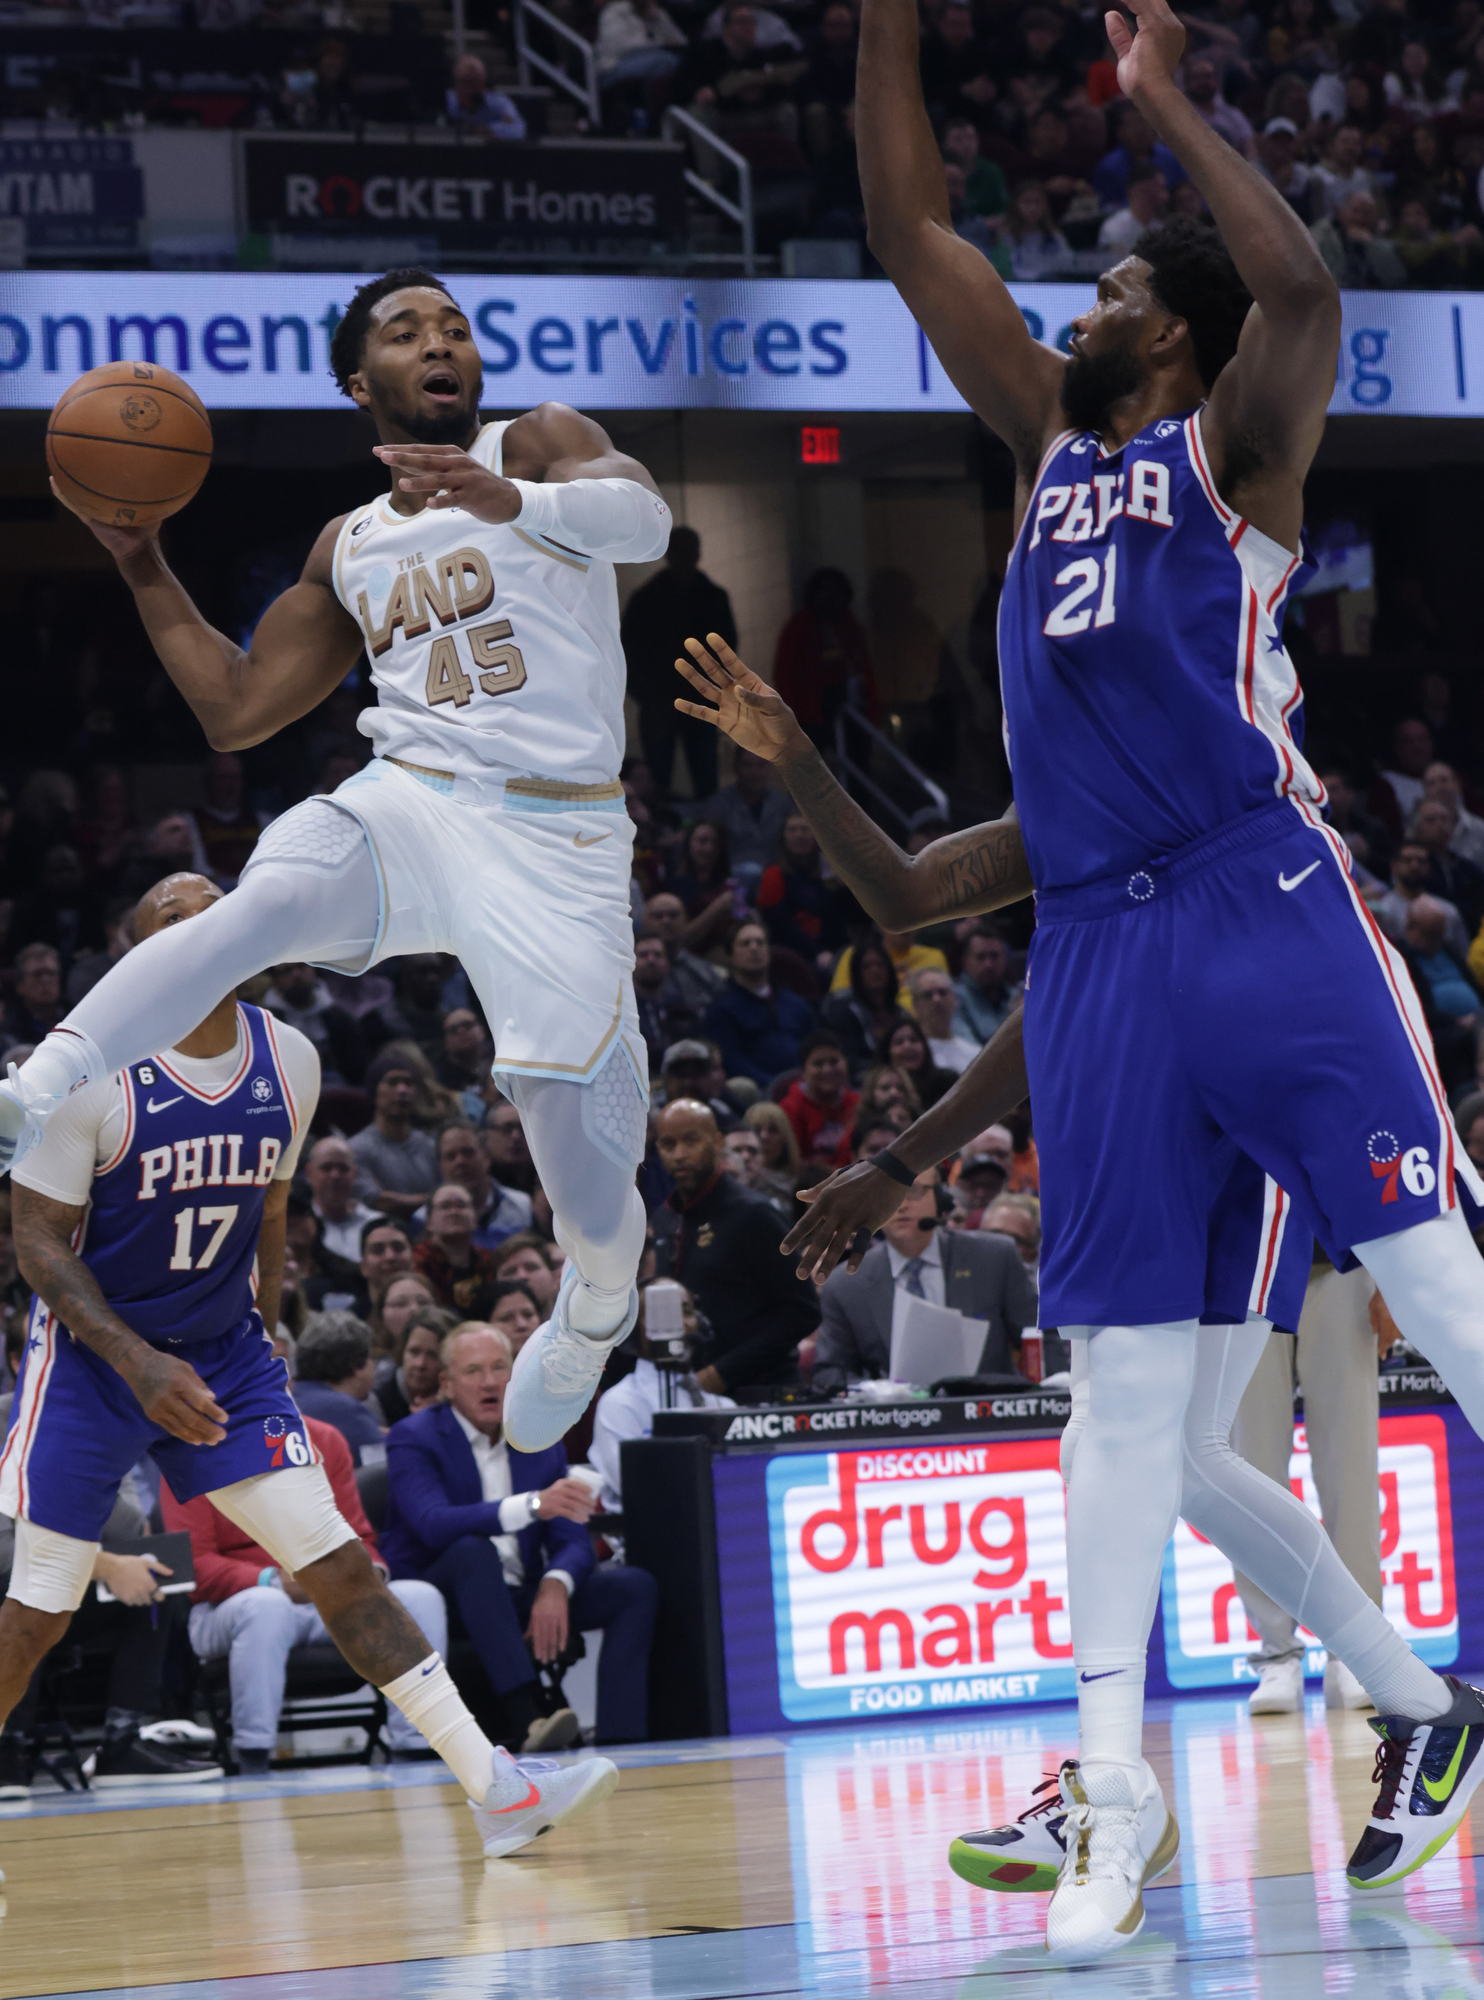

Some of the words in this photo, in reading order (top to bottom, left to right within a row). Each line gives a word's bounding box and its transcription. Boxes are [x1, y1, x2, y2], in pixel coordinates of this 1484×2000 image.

[284, 173, 494, 220] ROCKET
[502, 180, 657, 226] Homes
[475, 296, 848, 376] Services
[397, 551, 425, 572] THE
[1042, 543, 1117, 637] 21
[356, 546, 495, 658] LAND
[425, 618, 528, 709] 45
[138, 1066, 155, 1085] 6
[246, 1105, 283, 1115] crypto.com
[136, 1134, 282, 1201] PHILA
[1369, 1146, 1436, 1206] 76
[169, 1205, 239, 1271] 17
[264, 1431, 309, 1468] 76
[724, 1414, 781, 1440] ANC
[783, 1410, 857, 1432] ROCKET
[860, 1407, 942, 1429] Mortgage
[964, 1399, 1039, 1420] ROCKET
[857, 1448, 987, 1480] DISCOUNT
[801, 1453, 1028, 1590] drug
[829, 1580, 1074, 1676] mart
[850, 1684, 923, 1711] FOOD
[930, 1674, 1041, 1705] MARKET
